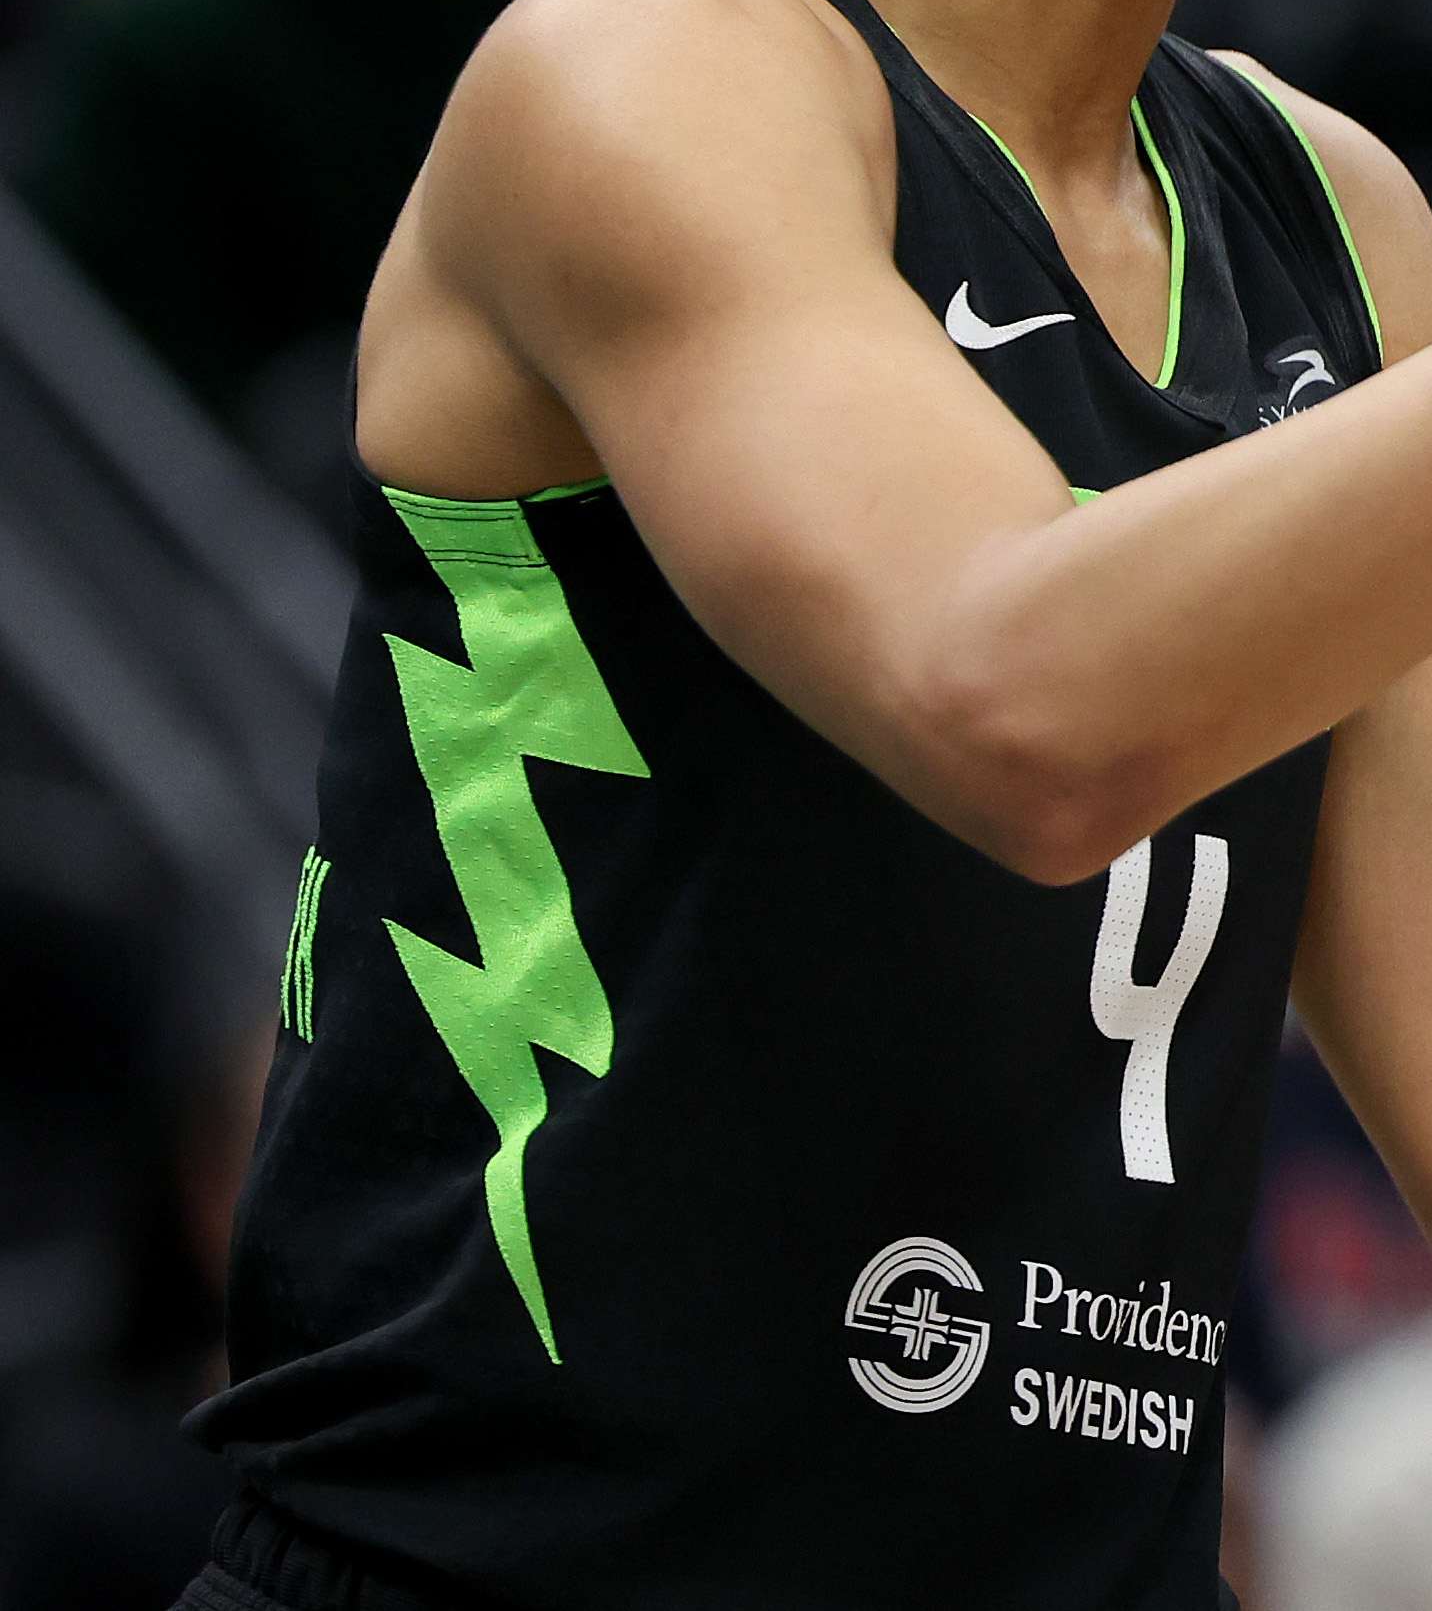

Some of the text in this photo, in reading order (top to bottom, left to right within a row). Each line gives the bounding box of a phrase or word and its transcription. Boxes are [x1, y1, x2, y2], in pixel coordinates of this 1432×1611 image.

[1088, 834, 1230, 1184] 4
[1016, 1260, 1228, 1366] Providenc
[1009, 1367, 1195, 1455] SWEDISH
